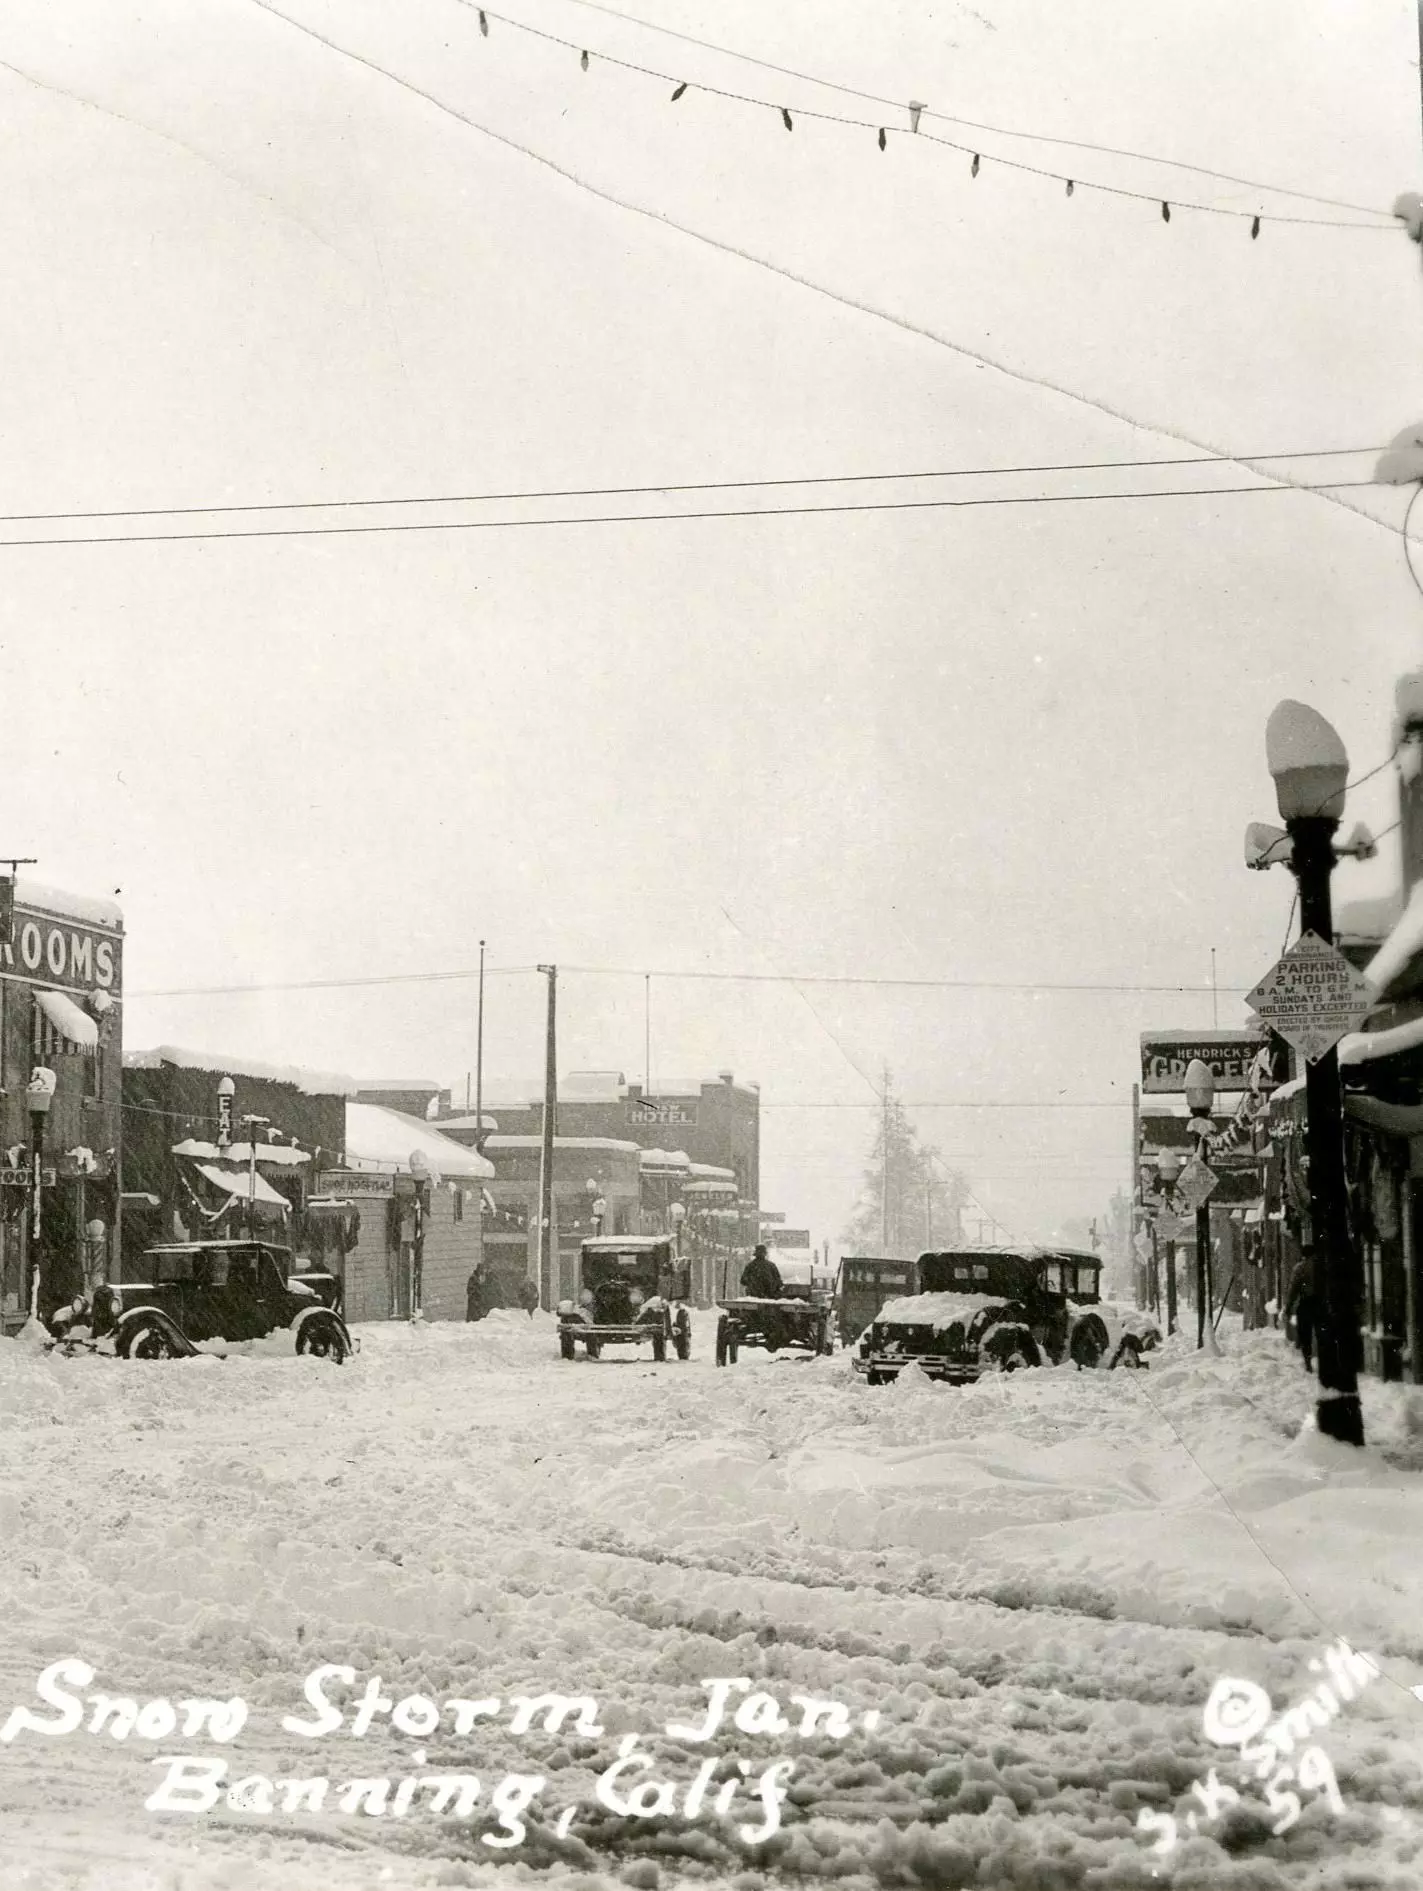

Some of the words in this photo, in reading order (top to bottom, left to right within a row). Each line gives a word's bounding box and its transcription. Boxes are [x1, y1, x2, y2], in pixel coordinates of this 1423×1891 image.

[1277, 960, 1346, 974] PARKING
[1275, 975, 1286, 986] 2
[1292, 972, 1350, 985] HOURS
[1305, 985, 1322, 994] TO
[1273, 994, 1323, 1004] SUNDAYS
[1329, 993, 1352, 1002] AND
[1259, 1003, 1309, 1014] HOLIDAYS
[1313, 1001, 1367, 1012] EXCEPTED
[219, 1096, 231, 1146] EAT
[631, 1111, 694, 1123] HOTEL
